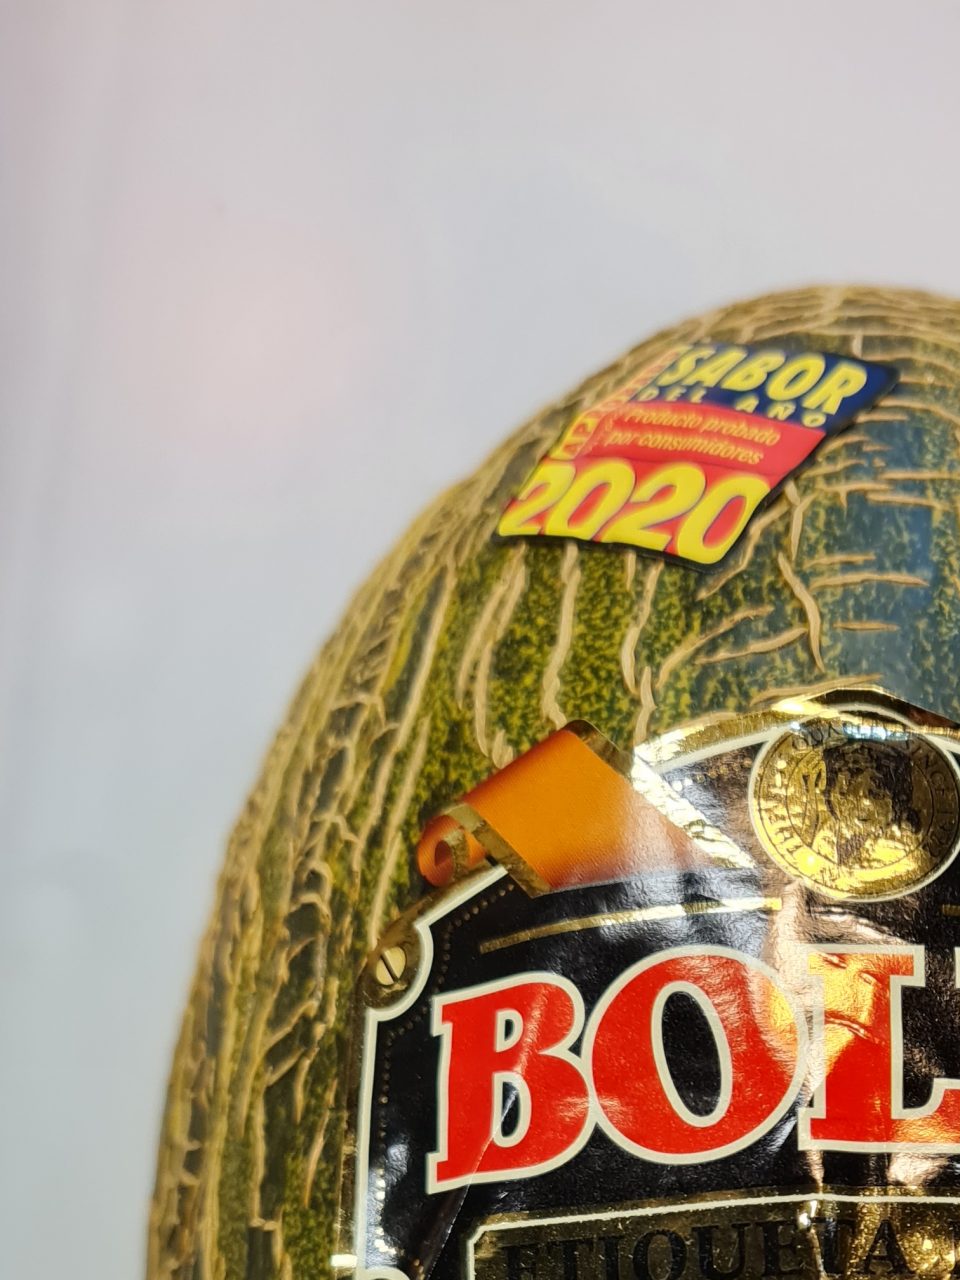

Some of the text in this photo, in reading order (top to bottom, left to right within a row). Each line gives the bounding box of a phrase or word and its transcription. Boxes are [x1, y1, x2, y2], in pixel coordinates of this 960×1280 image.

[637, 384, 708, 405] DEL
[655, 344, 868, 416] SABOR
[602, 428, 765, 466] por consumidores
[622, 407, 782, 447] Producto probado
[498, 457, 769, 564] 2020
